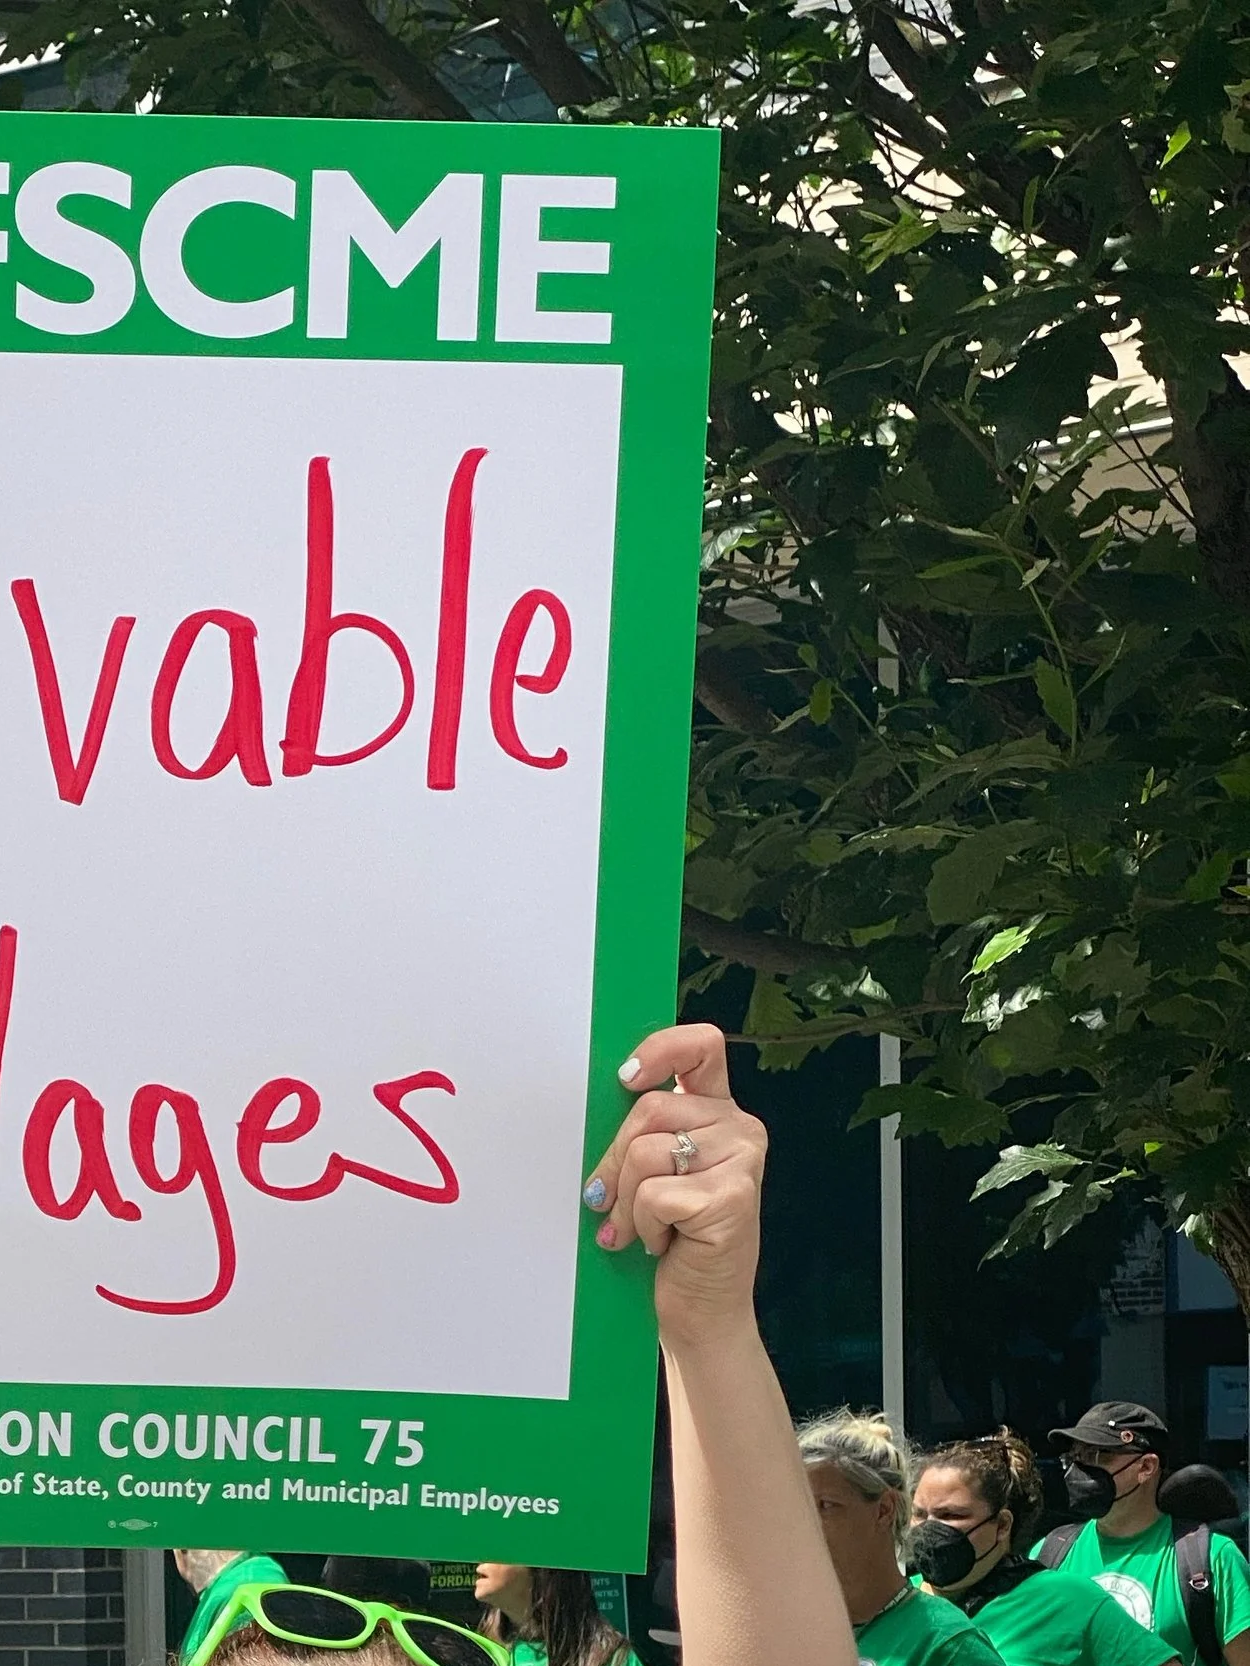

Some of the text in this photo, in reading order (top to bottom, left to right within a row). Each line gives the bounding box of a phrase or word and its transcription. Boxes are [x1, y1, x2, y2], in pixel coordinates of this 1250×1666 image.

[98, 1412, 337, 1463] COUNCIL
[360, 1419, 425, 1467] 75
[32, 1472, 109, 1501] State,
[117, 1474, 212, 1505] County
[221, 1477, 271, 1501] and
[282, 1478, 409, 1511] Municipal
[420, 1484, 560, 1518] Employees
